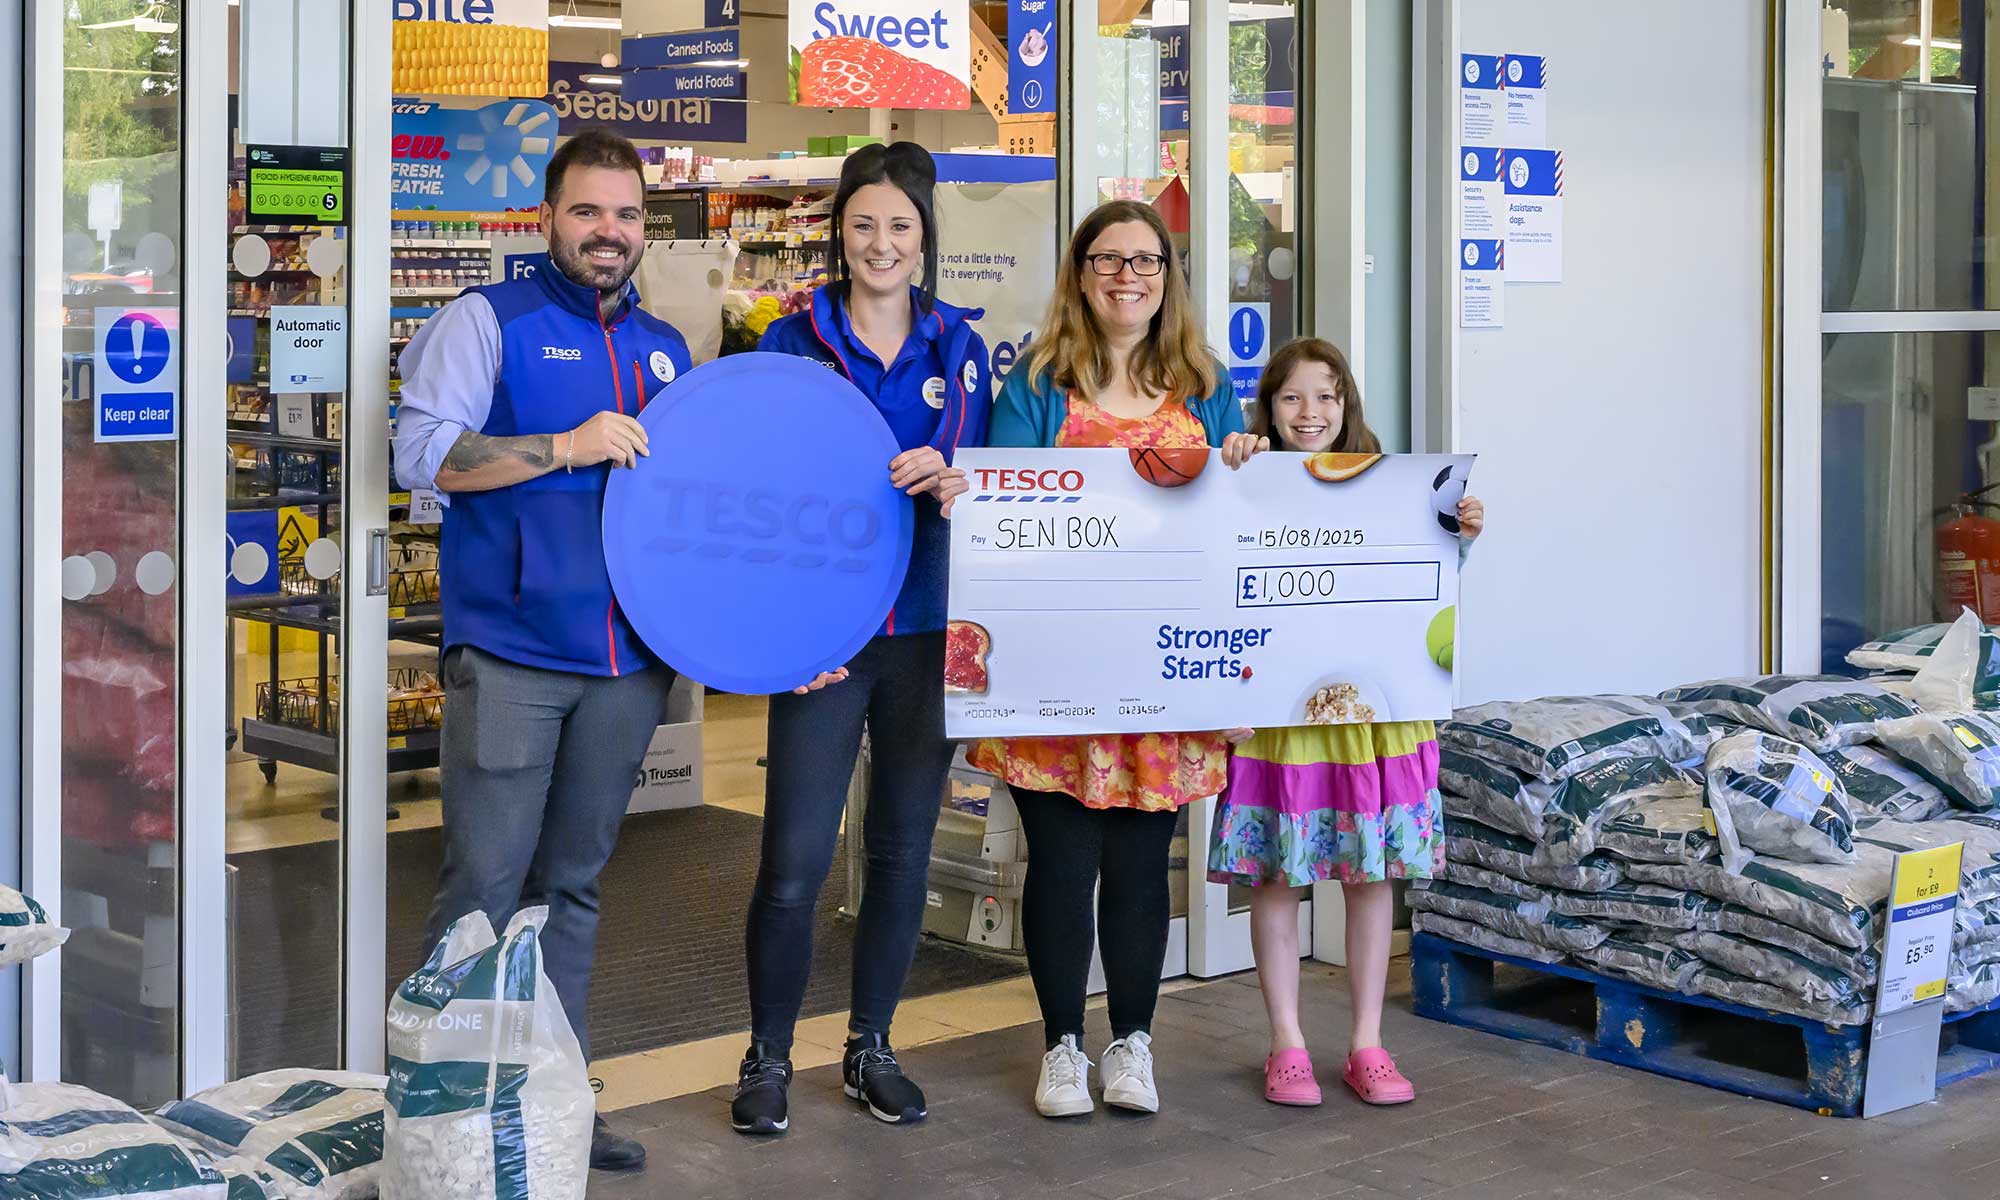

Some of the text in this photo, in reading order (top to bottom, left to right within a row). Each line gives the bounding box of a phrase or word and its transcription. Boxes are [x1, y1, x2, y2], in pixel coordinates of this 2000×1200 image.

[722, 0, 735, 19] 4
[1021, 0, 1046, 13] Sugar
[812, 2, 949, 49] Sweet
[667, 39, 733, 57] Canned Foods
[675, 74, 734, 90] World Foods
[553, 80, 711, 124] Seasonal
[256, 173, 279, 181] FOOD
[280, 174, 310, 182] HYGIENE
[325, 195, 335, 209] 5
[948, 254, 962, 263] not
[972, 252, 991, 264] little
[994, 253, 1017, 267] thing.
[943, 268, 1004, 282] It's everything.
[275, 319, 341, 332] Automatic
[294, 336, 324, 348] door
[105, 406, 170, 424] Keep clear
[973, 469, 1085, 491] TESCO
[653, 476, 882, 551] TESCO
[971, 515, 1119, 548] Pay SEN BOX
[1237, 535, 1255, 543] Date
[1157, 624, 1272, 654] Stronger
[648, 764, 692, 780] Trussell
[1929, 883, 1939, 894] £9
